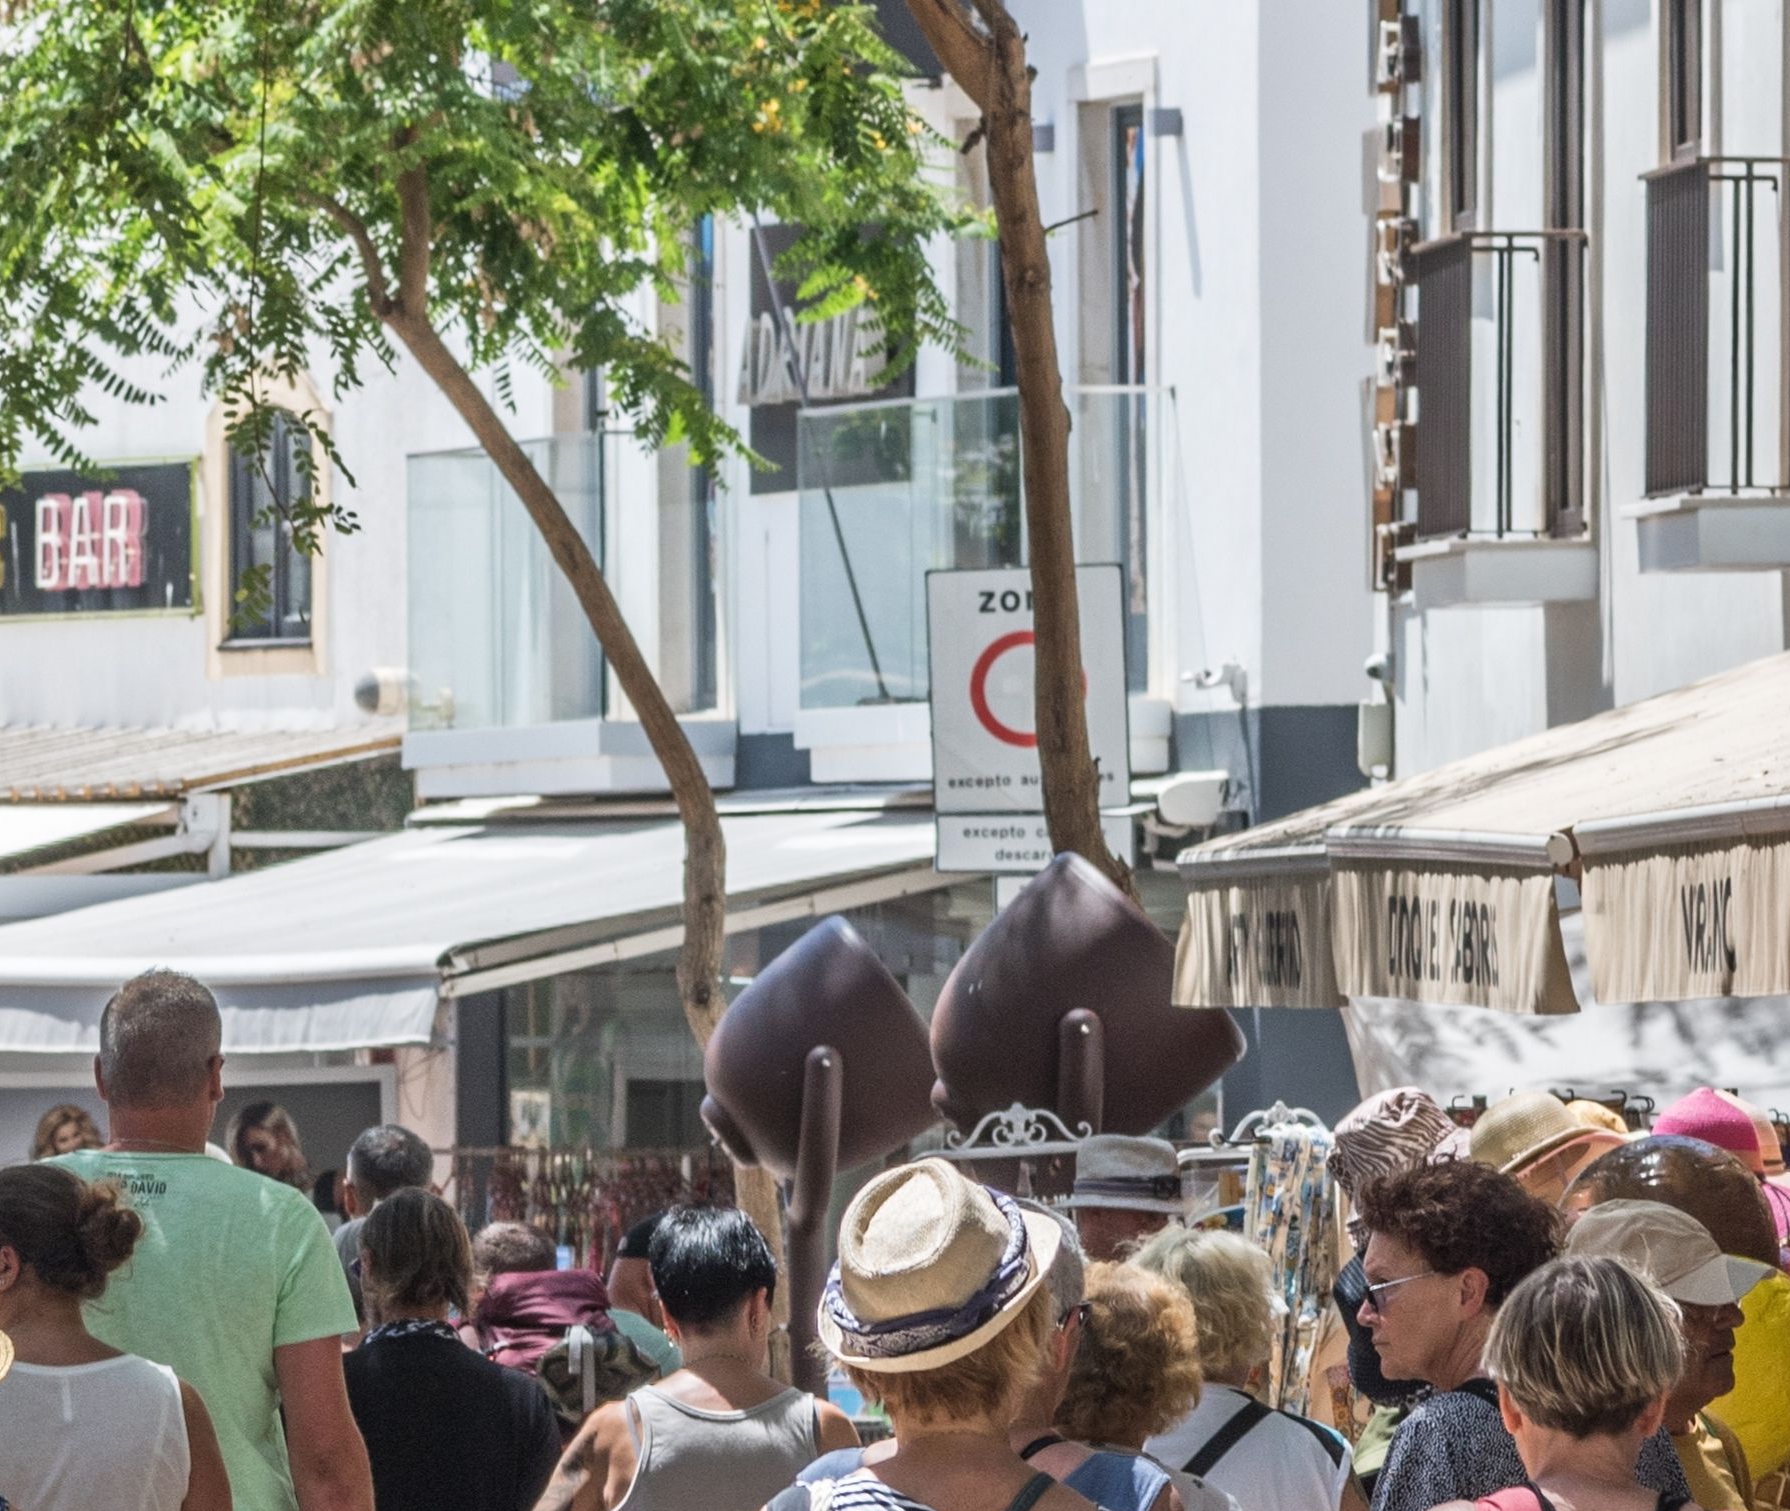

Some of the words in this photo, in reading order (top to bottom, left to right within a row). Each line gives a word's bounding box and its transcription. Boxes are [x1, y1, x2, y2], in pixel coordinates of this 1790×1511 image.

[36, 490, 147, 591] BAR
[978, 590, 1033, 613] ZO
[948, 772, 1012, 789] excepto
[963, 825, 1026, 840] excepto
[995, 848, 1054, 862] descar
[130, 1181, 167, 1195] DAVID
